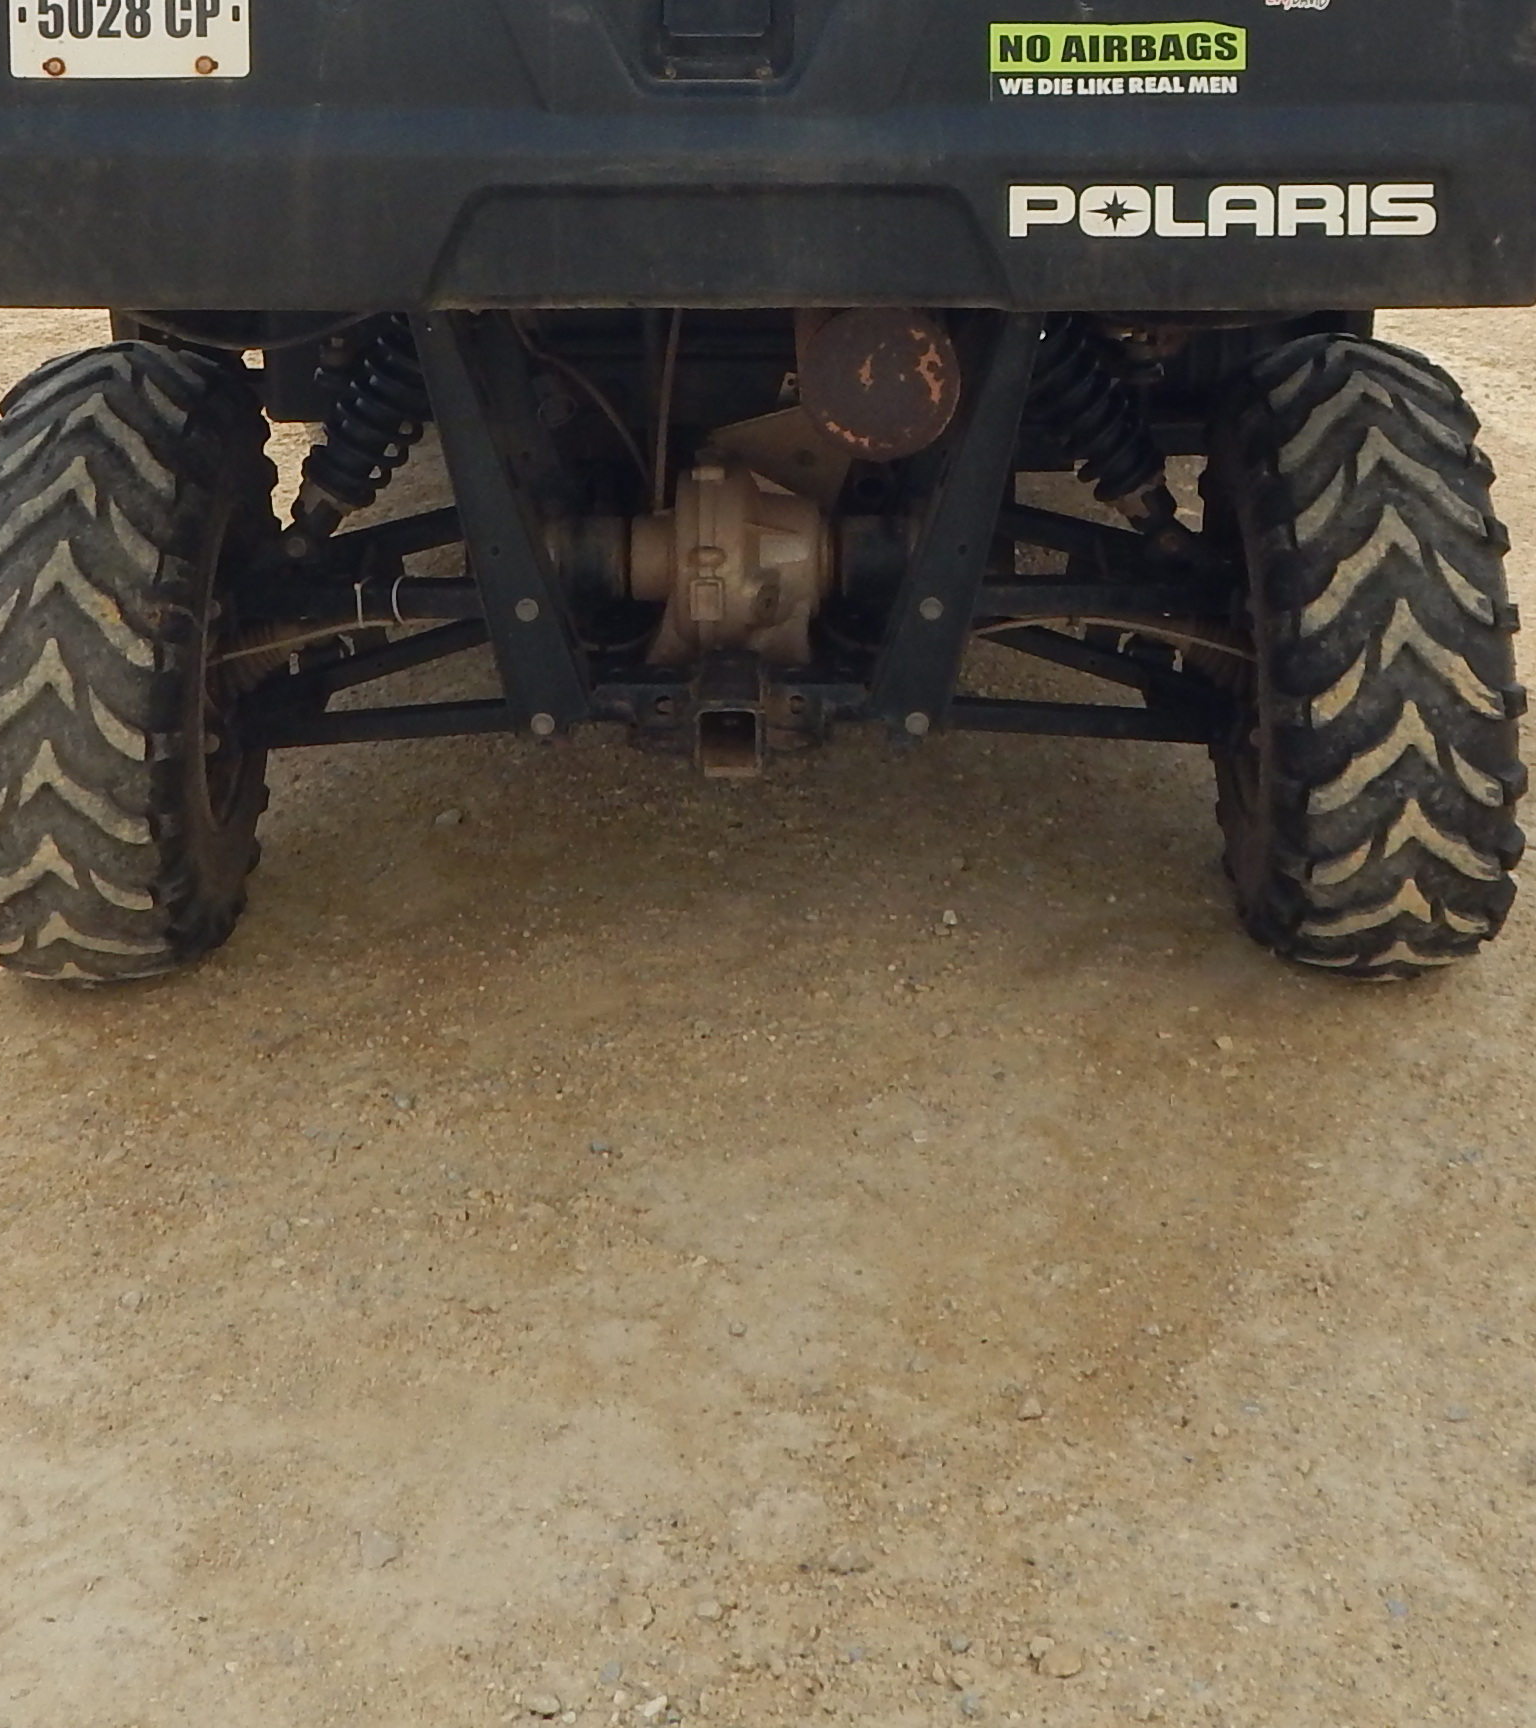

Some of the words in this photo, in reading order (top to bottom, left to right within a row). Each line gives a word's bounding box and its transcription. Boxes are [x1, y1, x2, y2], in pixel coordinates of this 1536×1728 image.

[999, 34, 1051, 63] NO
[1061, 32, 1238, 63] AIRBAGS
[999, 78, 1034, 95] WE
[1037, 78, 1073, 95] DIE
[1077, 77, 1125, 95] LIKE
[1128, 76, 1185, 94] REAL
[1188, 76, 1238, 94] MEN
[1008, 183, 1438, 238] POLARIS
